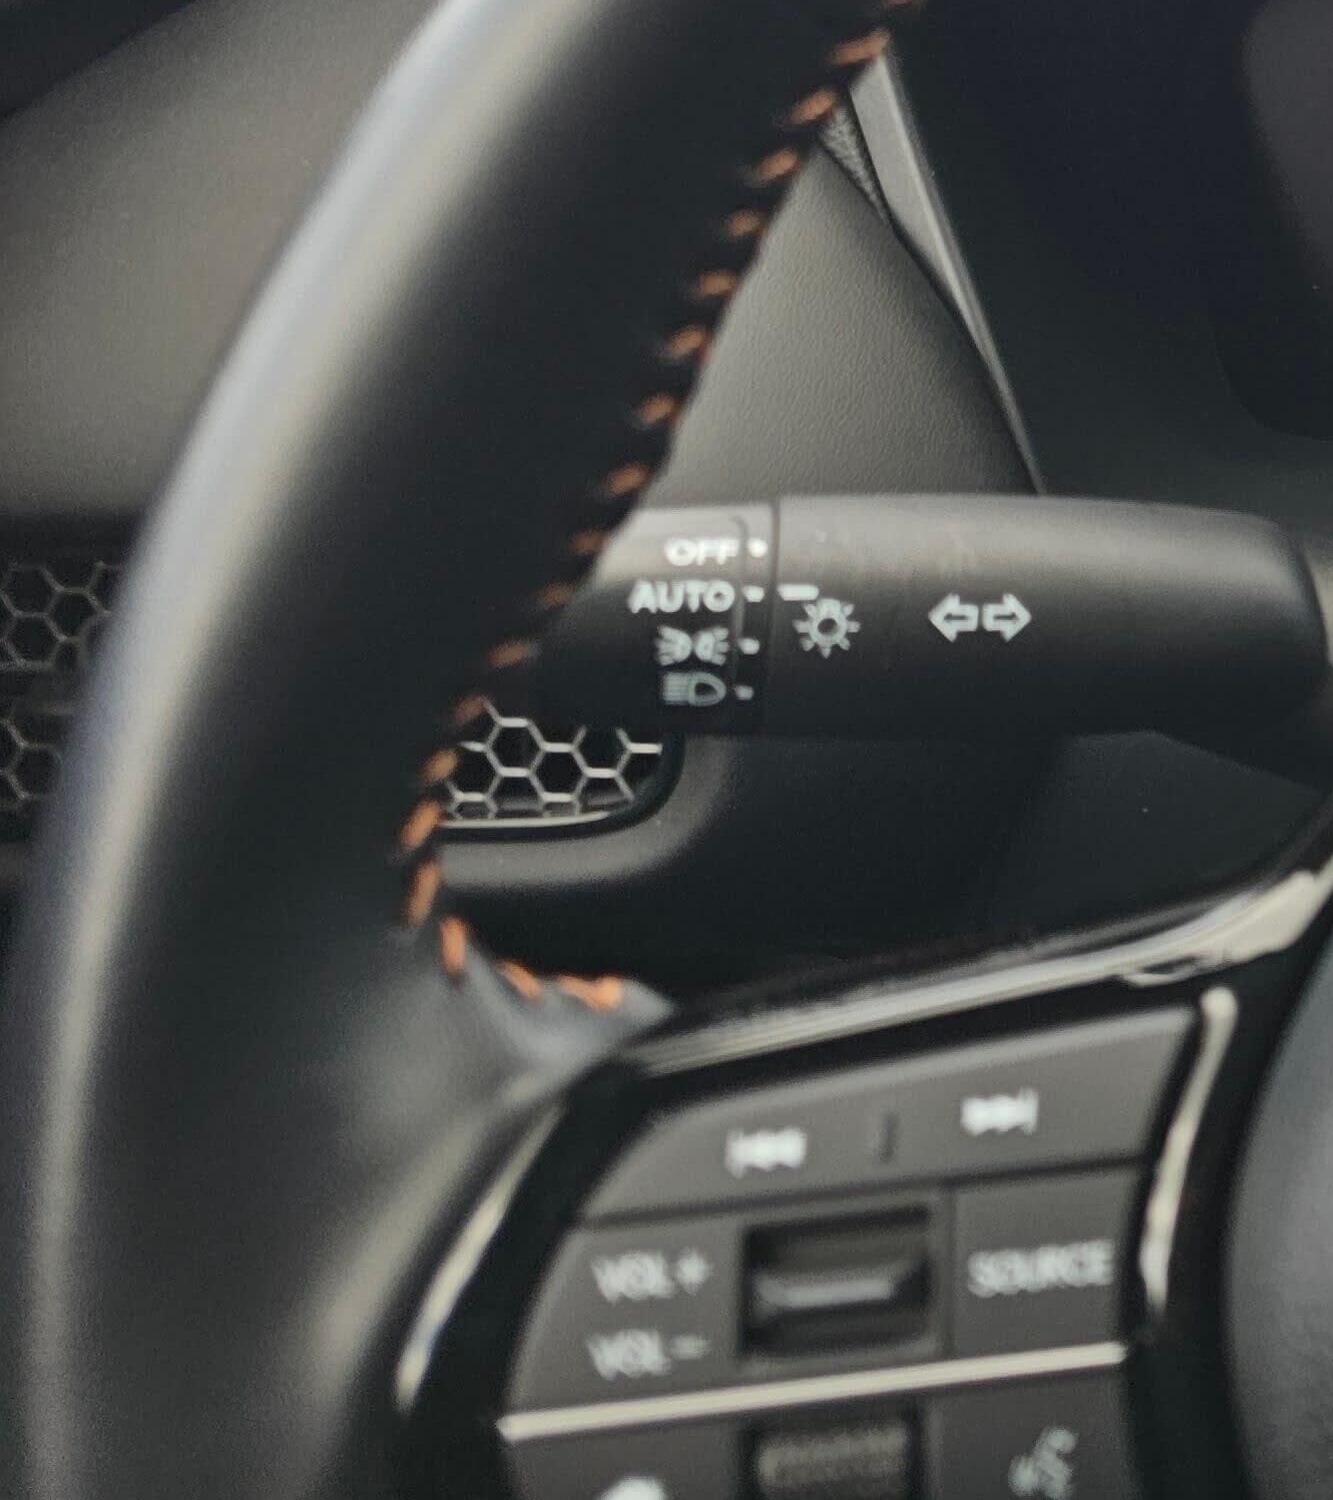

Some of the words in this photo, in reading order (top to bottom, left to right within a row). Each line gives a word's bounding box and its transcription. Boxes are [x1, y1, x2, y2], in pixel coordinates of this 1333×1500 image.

[663, 537, 741, 567] OFF
[627, 580, 736, 615] AUTO
[967, 1239, 1114, 1299] SOURCE
